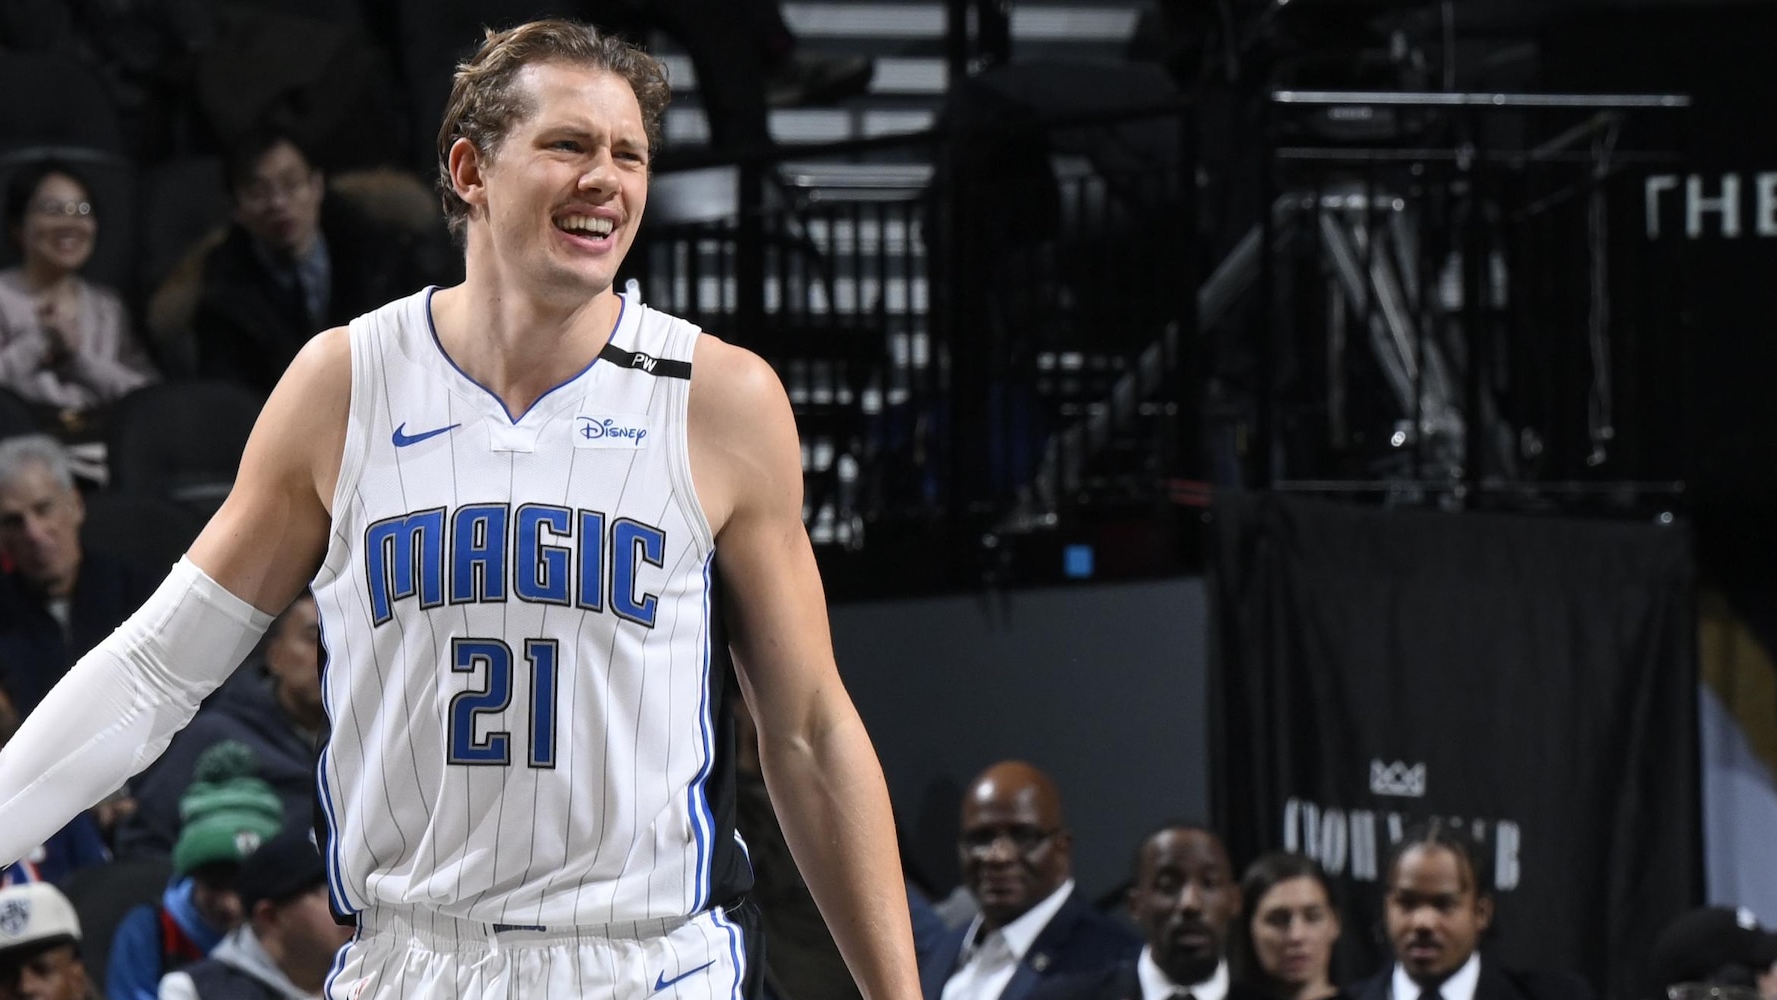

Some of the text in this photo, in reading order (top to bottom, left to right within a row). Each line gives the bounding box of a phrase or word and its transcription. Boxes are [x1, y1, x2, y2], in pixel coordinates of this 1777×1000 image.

[632, 354, 657, 372] PW
[364, 502, 666, 629] MAGIC
[447, 637, 559, 769] 21
